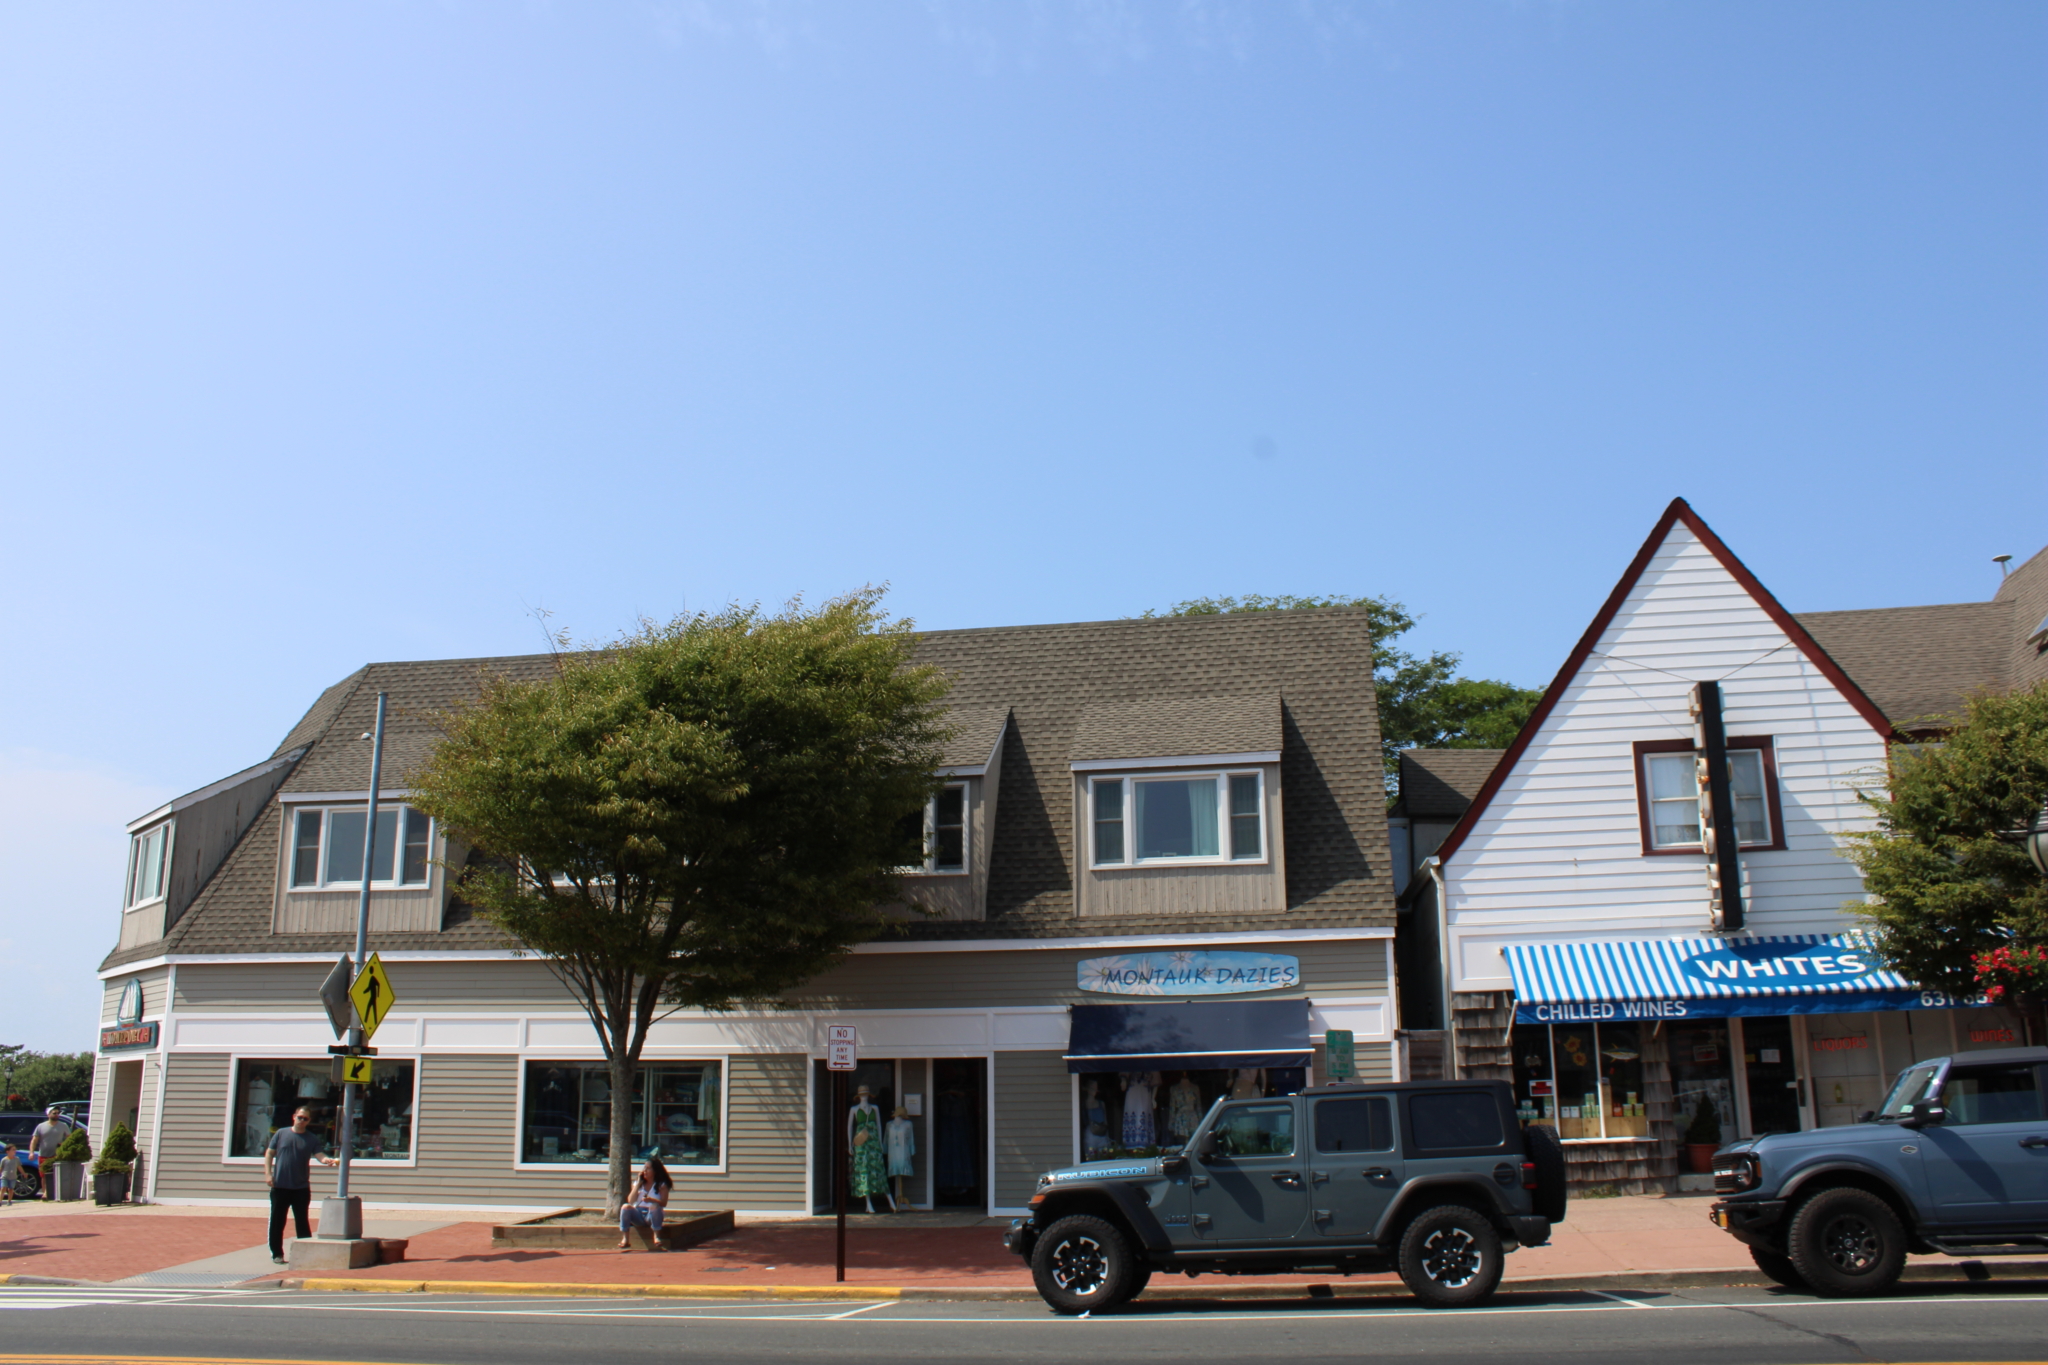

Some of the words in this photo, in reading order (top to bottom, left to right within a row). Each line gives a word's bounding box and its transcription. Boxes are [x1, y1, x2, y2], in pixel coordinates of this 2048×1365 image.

[1695, 954, 1867, 979] WHITES
[1104, 966, 1208, 985] MONTAUK
[1217, 966, 1296, 984] DAZIES
[1536, 1002, 1615, 1021] CHILLED
[1621, 1001, 1688, 1018] WINES
[837, 1029, 847, 1038] NO
[1969, 1029, 2015, 1043] WINES
[1813, 1036, 1868, 1051] LIQUORS
[1057, 1166, 1147, 1181] RUBICON
